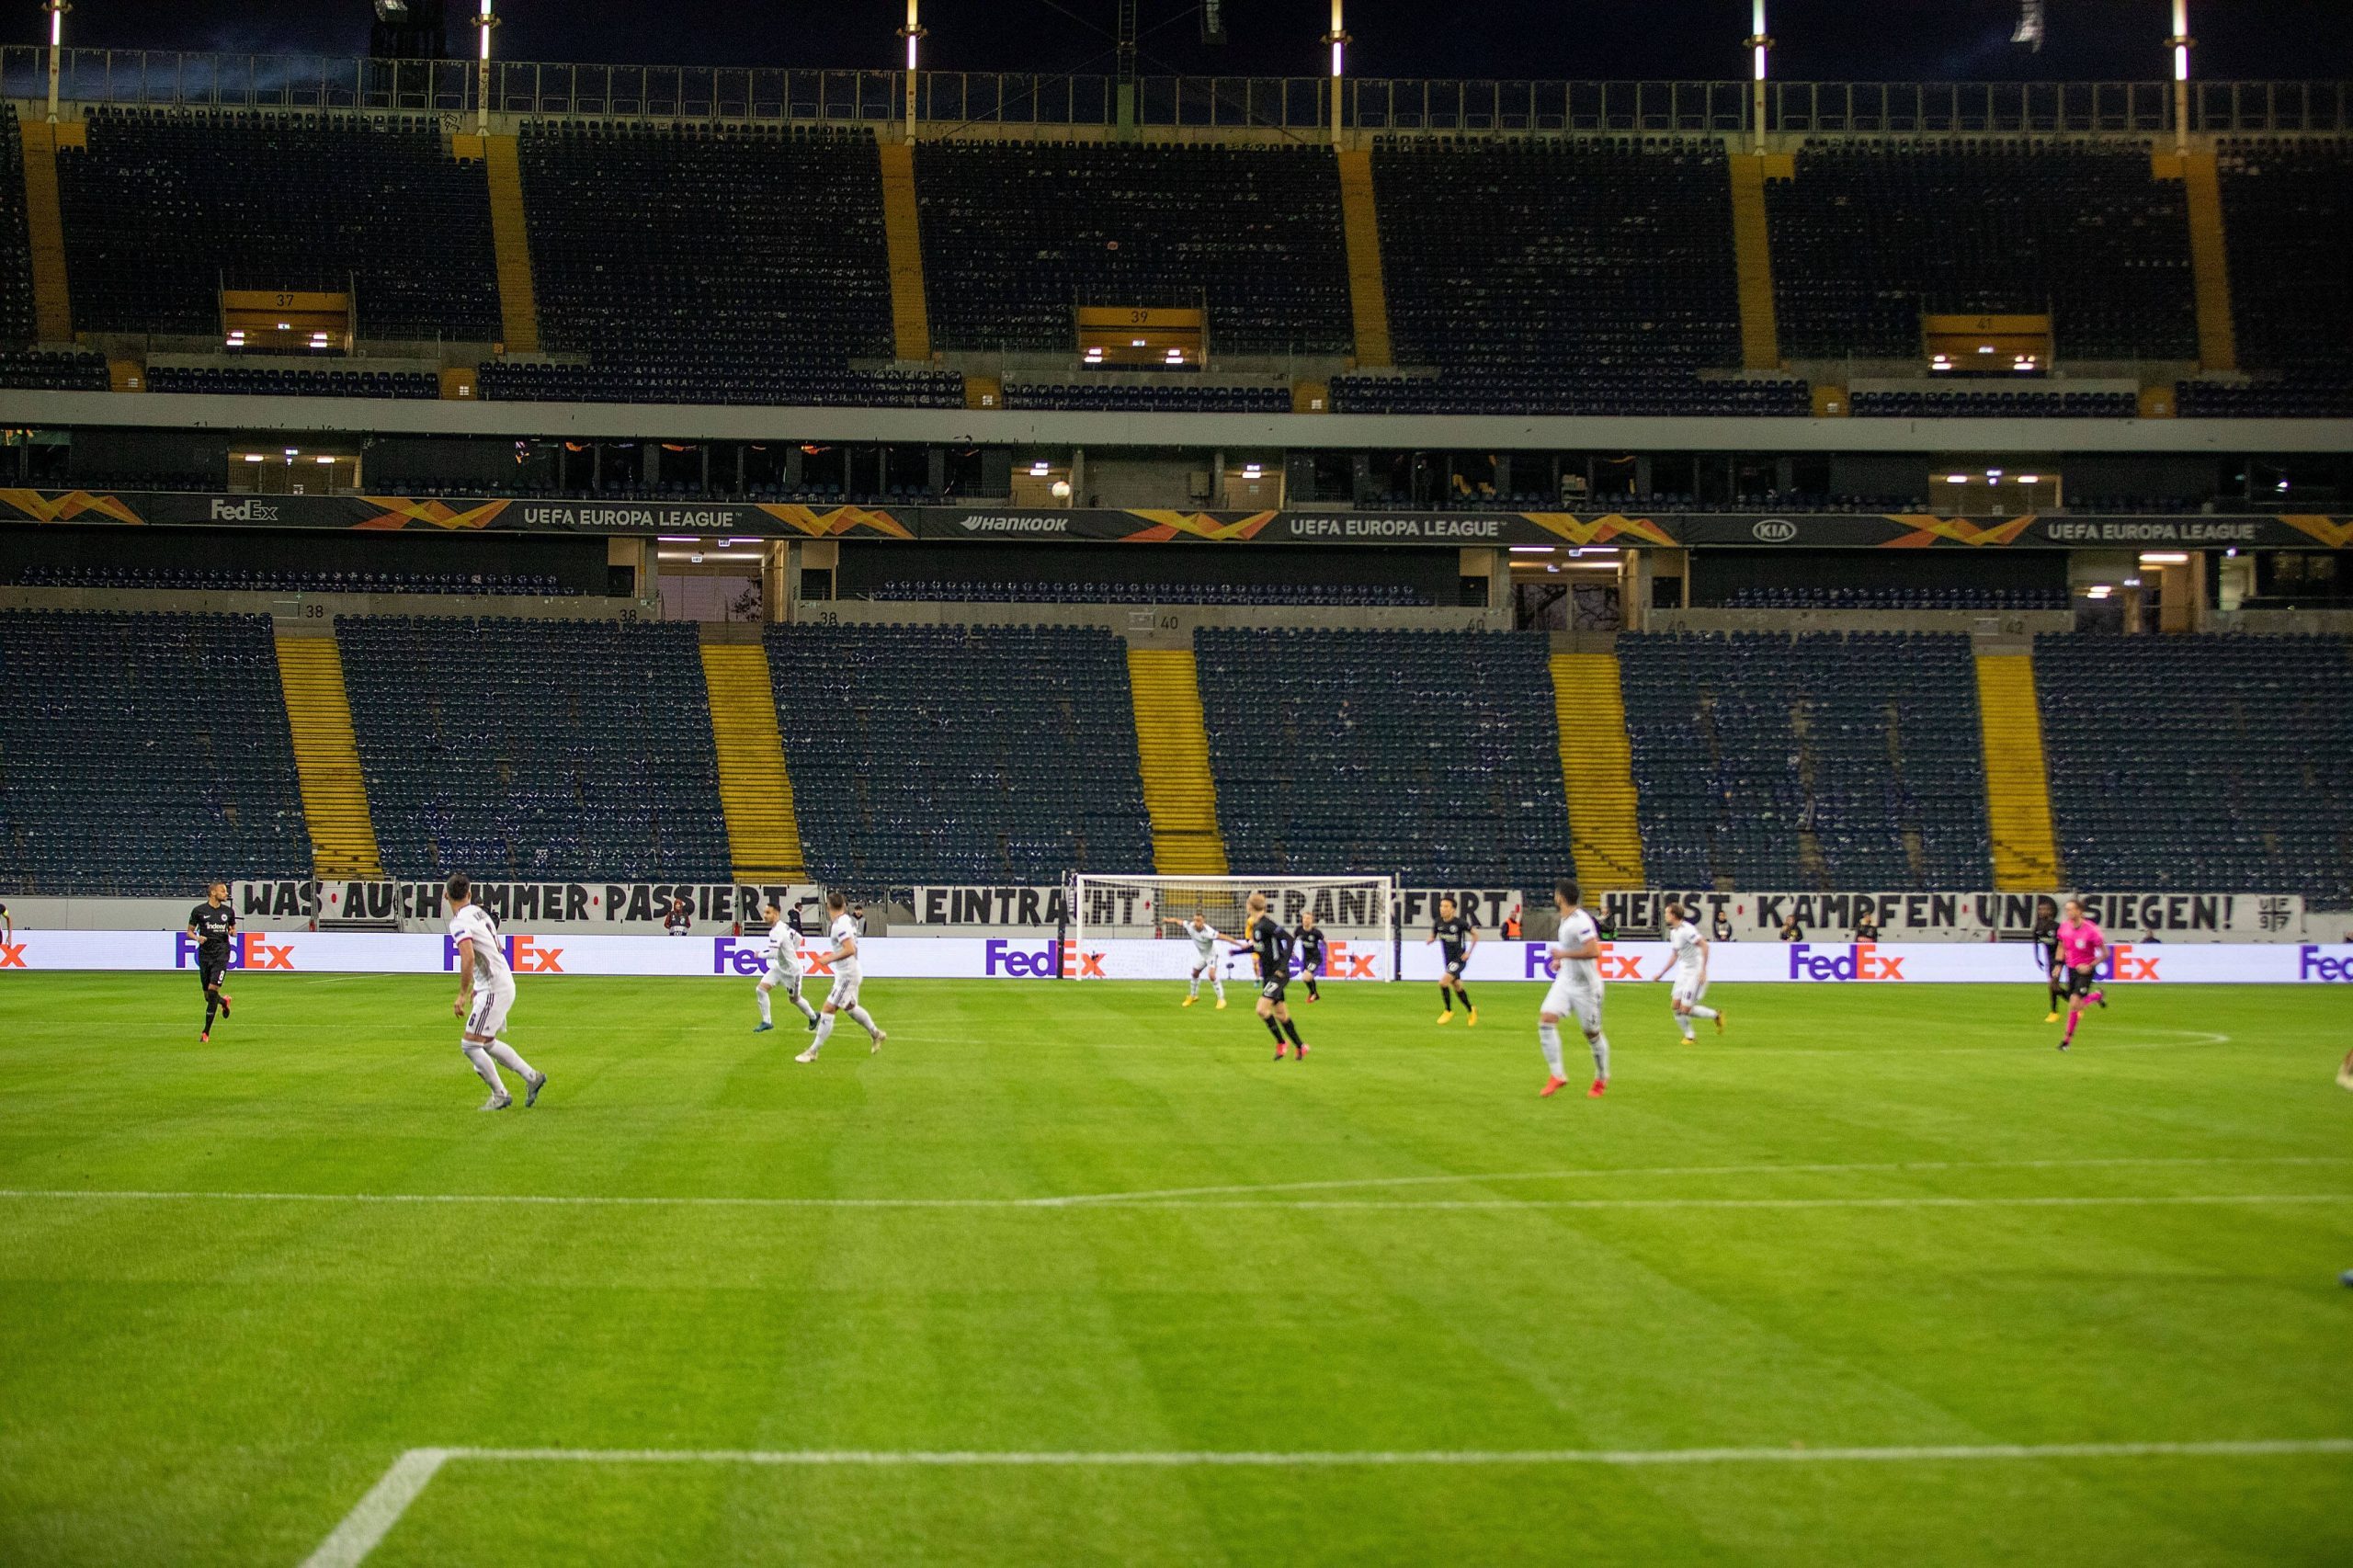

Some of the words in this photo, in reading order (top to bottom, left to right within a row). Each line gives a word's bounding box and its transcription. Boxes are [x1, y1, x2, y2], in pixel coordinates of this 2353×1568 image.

[277, 294, 294, 306] 37
[1131, 311, 1148, 323] 39
[211, 499, 278, 520] FedEx
[525, 508, 574, 525] UEFA
[580, 510, 654, 526] EUROPA
[1290, 519, 1340, 535] UEFA
[1346, 520, 1419, 536] EUROPA
[1425, 520, 1498, 537] LEAGUE
[1760, 524, 1789, 538] KIA
[2048, 524, 2098, 540] UEFA
[2102, 524, 2177, 540] EUROPA
[2181, 525, 2255, 540] LEAGUE
[306, 605, 323, 618] 38
[620, 608, 637, 621] 38
[820, 612, 837, 625] 38
[1161, 617, 1178, 630] 40
[1468, 619, 1485, 631] 40
[244, 882, 323, 916] WAS
[176, 932, 294, 970] FdEx
[986, 939, 1107, 977] FedEx
[1790, 944, 1904, 980] FedEx
[219, 971, 225, 981] 8
[468, 1013, 476, 1027] 6
